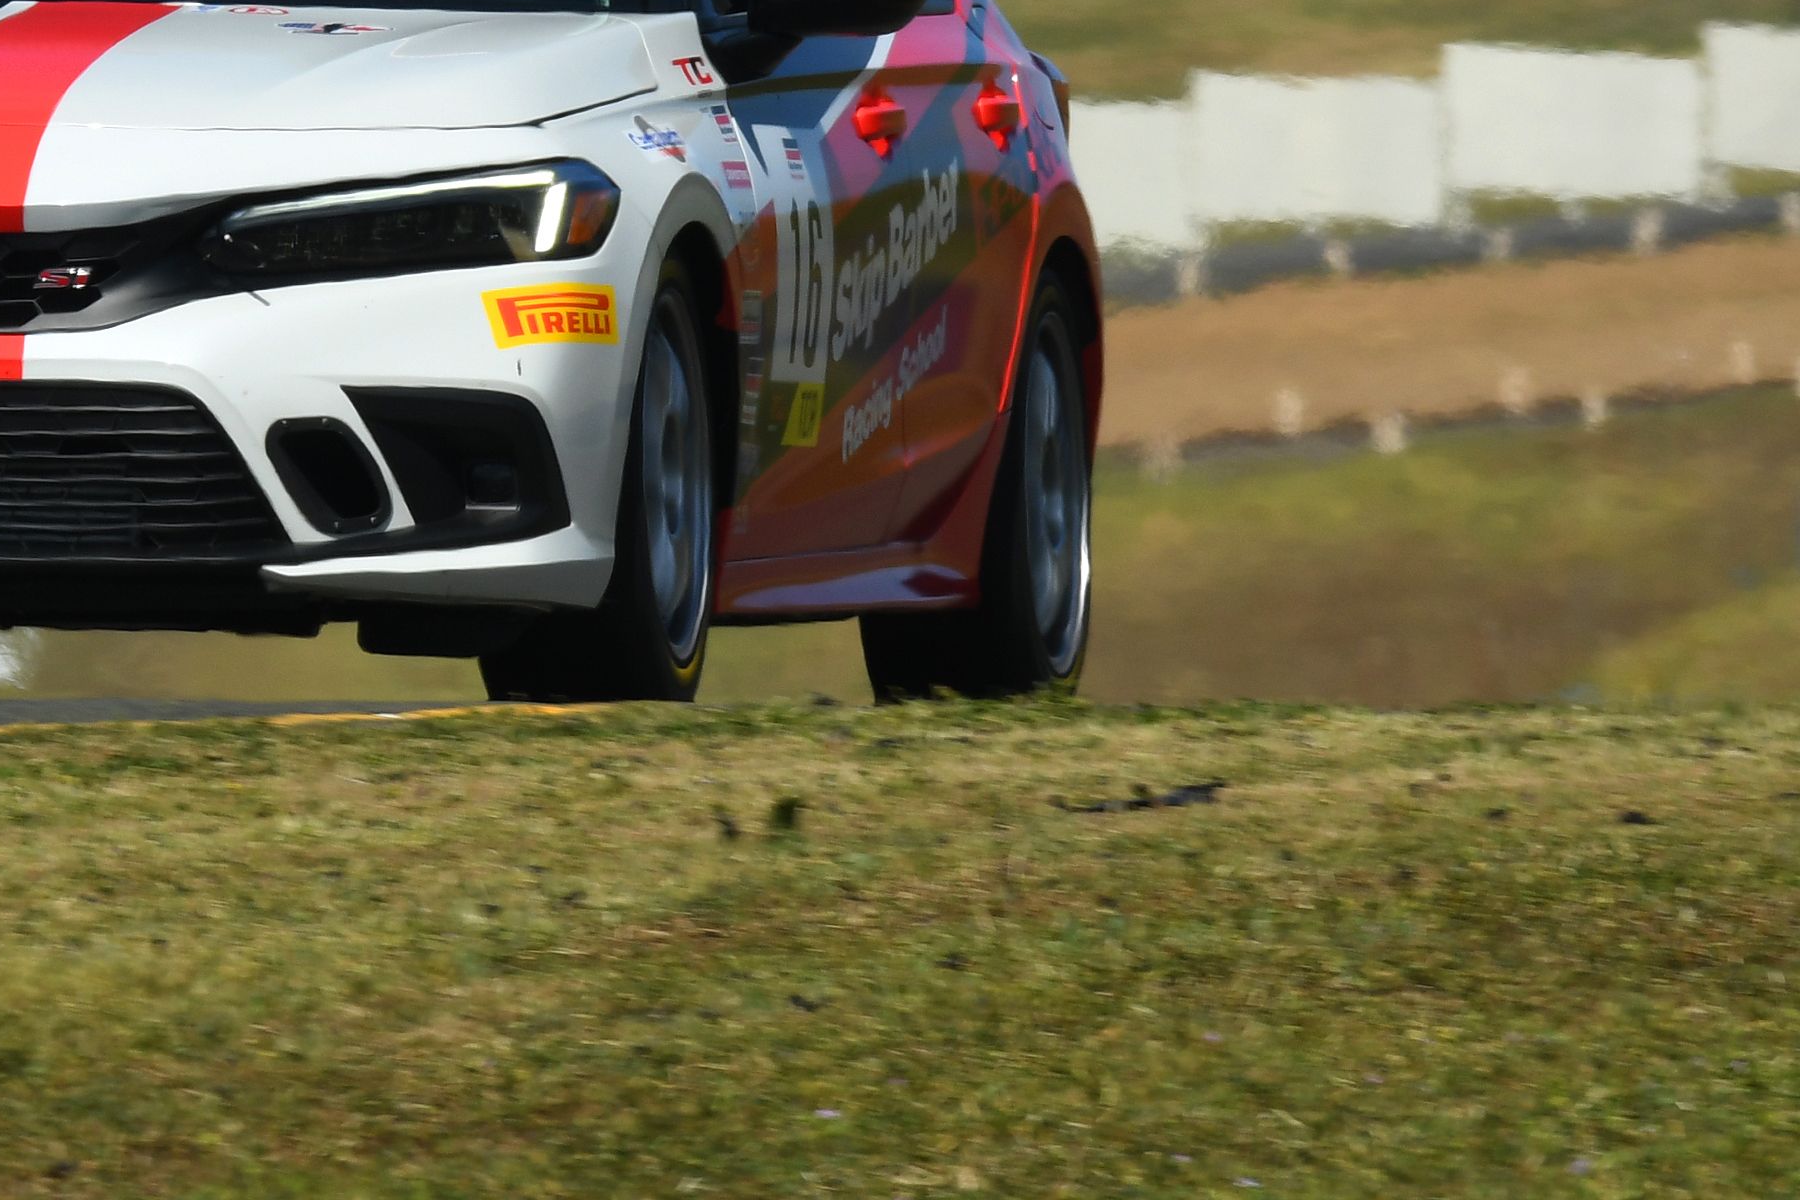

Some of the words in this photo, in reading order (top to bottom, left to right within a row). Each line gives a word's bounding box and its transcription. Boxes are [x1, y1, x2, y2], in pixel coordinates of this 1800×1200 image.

[671, 56, 713, 85] TC
[788, 196, 825, 368] 16
[831, 234, 886, 362] Skip
[885, 156, 959, 307] Barber
[496, 292, 611, 338] PIRELLI
